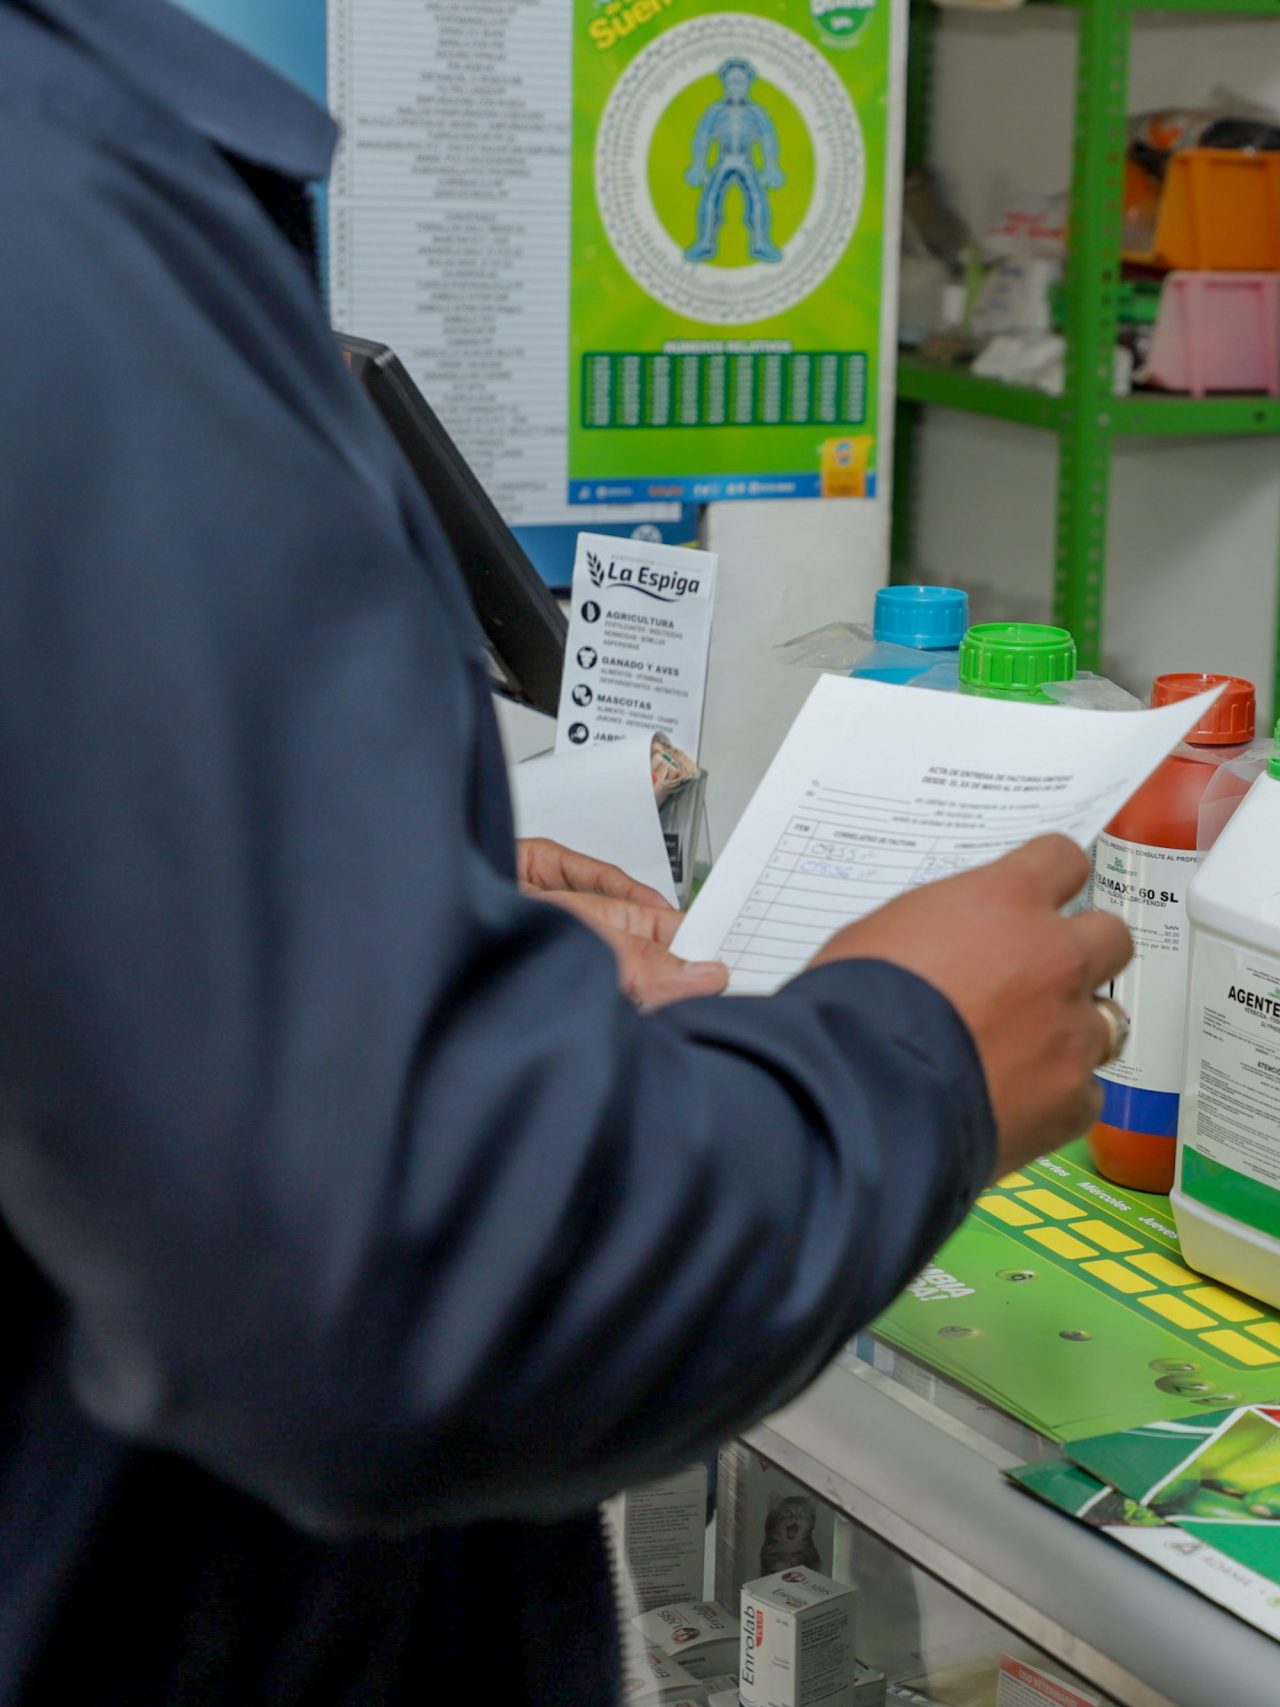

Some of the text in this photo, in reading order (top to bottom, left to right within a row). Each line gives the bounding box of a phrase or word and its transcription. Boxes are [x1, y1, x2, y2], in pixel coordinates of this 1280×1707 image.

[607, 561, 700, 598] La Espiga
[605, 610, 674, 628] AGRICULTURA
[601, 656, 679, 676] GANADO Y AVES
[596, 693, 651, 710] MASCOTAS
[1139, 888, 1155, 899] 60
[1161, 892, 1178, 903] SL
[1077, 1182, 1131, 1211] Miércoles
[1138, 1216, 1178, 1240] Jueves
[742, 1606, 755, 1686] Enrolab
